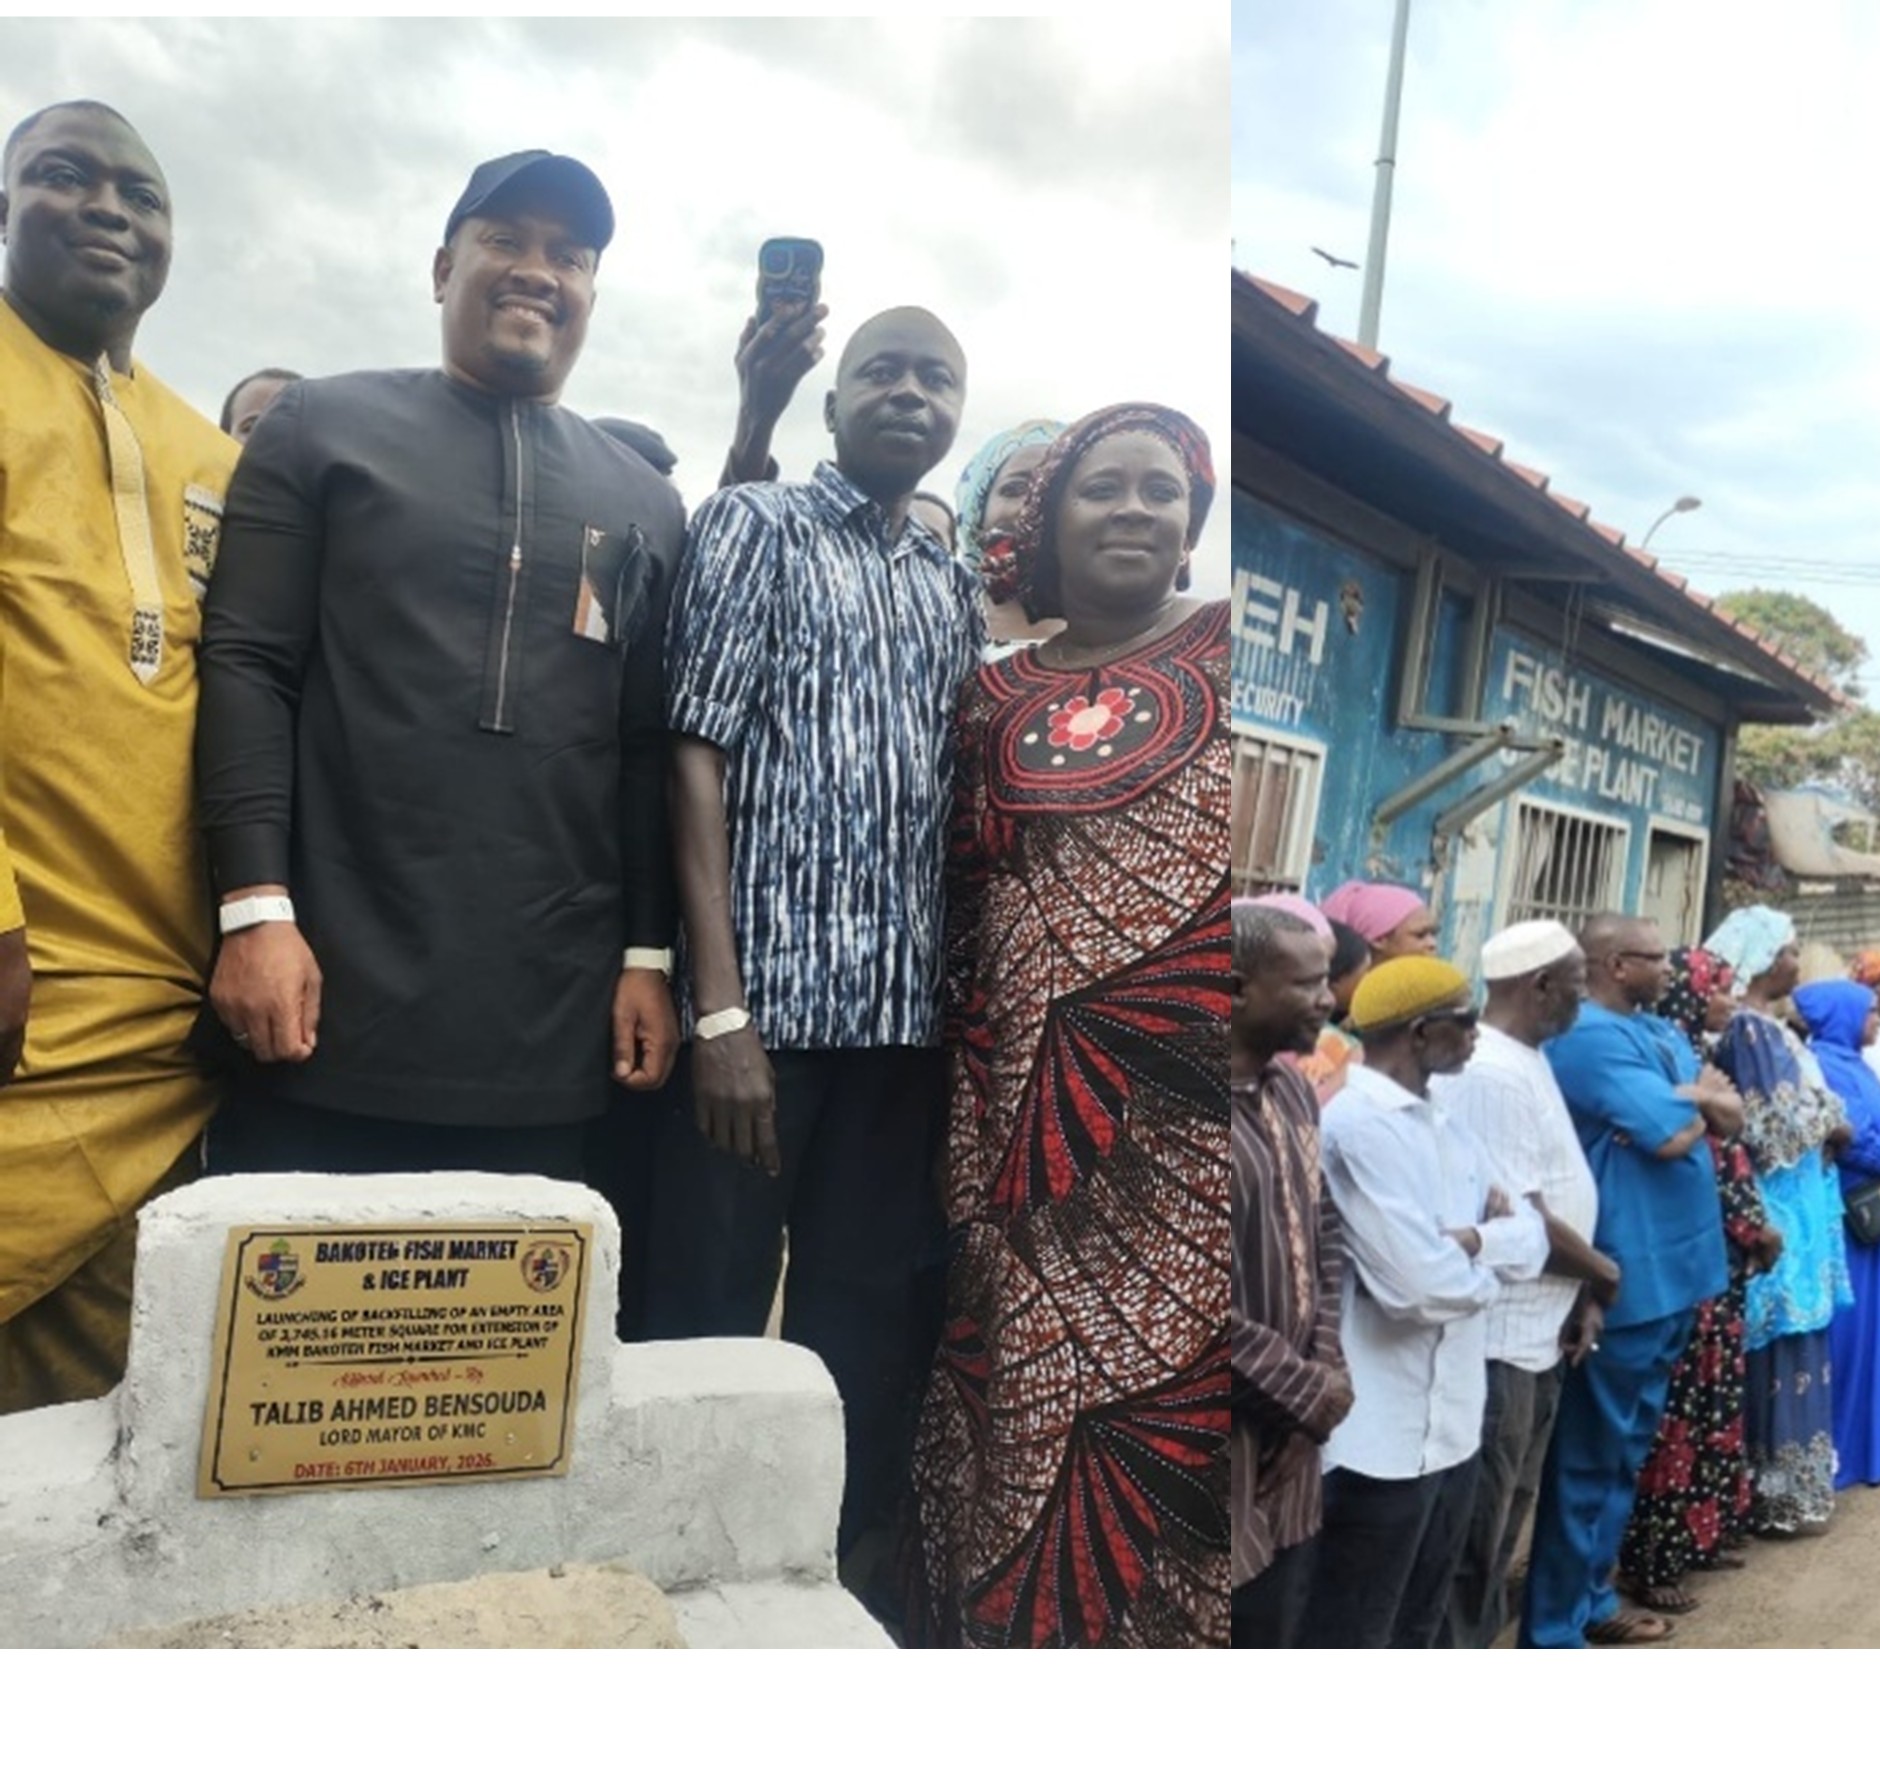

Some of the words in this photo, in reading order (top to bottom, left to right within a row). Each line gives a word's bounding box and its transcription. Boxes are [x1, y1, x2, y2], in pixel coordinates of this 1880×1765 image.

[1503, 650, 1591, 731] FISH
[1602, 696, 1704, 776] MARKET
[1582, 745, 1658, 809] PLANT
[404, 1240, 445, 1260] FISH
[448, 1240, 518, 1260] MARKET
[363, 1272, 375, 1290] &
[380, 1270, 411, 1290] ICE
[414, 1268, 469, 1290] PLANT
[256, 1310, 337, 1325] LAUNCHING
[341, 1309, 358, 1322] OF
[450, 1307, 466, 1319] OF
[469, 1306, 486, 1317] AN
[491, 1305, 532, 1317] EMPTY
[533, 1304, 565, 1316] AREA
[258, 1329, 277, 1341] OF
[342, 1326, 385, 1339] METER
[444, 1323, 467, 1335] FOR
[471, 1321, 540, 1334] EXTENSION
[543, 1321, 559, 1333] OF
[368, 1341, 400, 1354] FISH
[457, 1338, 484, 1350] AND
[487, 1337, 506, 1349] ICE
[510, 1336, 549, 1348] PLANT
[250, 1400, 324, 1426] TALIB
[330, 1396, 418, 1422] AHMED
[424, 1390, 546, 1418] BENSOUDA
[320, 1428, 362, 1446] LORD
[366, 1425, 421, 1444] MAYOR
[428, 1424, 447, 1440] OF
[452, 1422, 486, 1438] KMC
[294, 1461, 341, 1479] DATE:
[345, 1459, 375, 1475] 6TH
